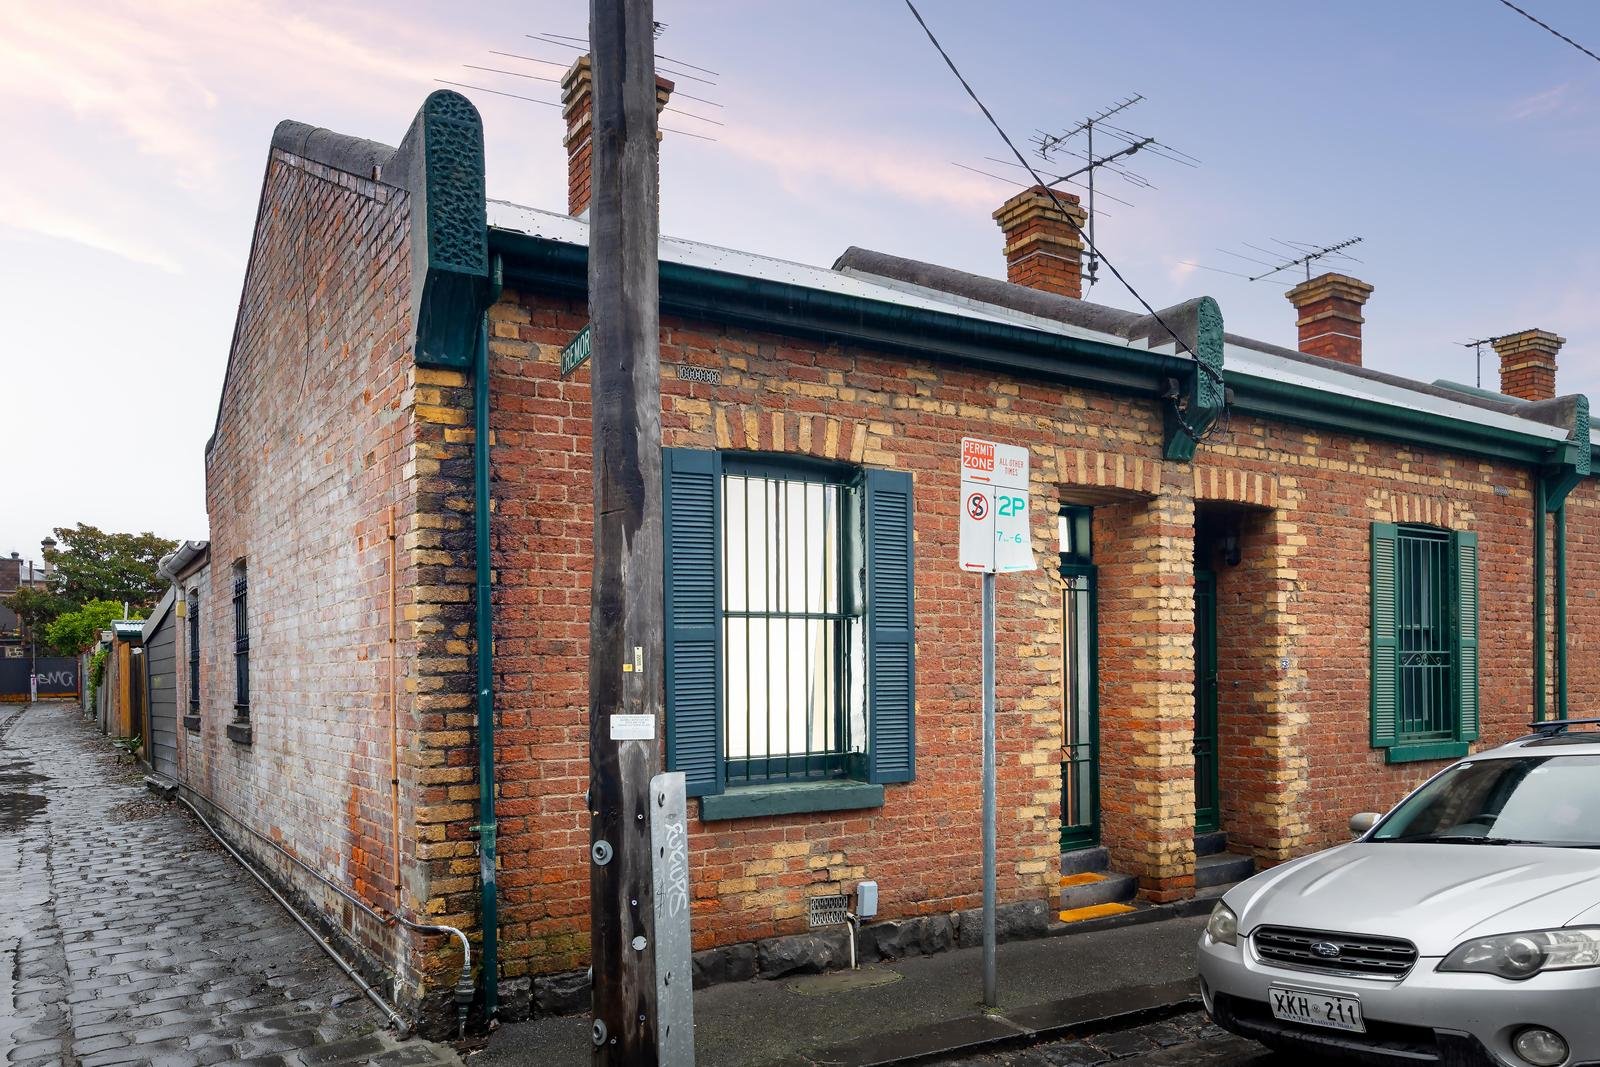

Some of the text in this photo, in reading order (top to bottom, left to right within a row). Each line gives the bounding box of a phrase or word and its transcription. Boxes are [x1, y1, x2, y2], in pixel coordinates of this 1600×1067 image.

[561, 329, 590, 375] CREMOR
[964, 441, 994, 457] PERMIT
[963, 455, 994, 471] ZONE
[998, 495, 1025, 517] 2P
[1274, 993, 1356, 1024] XKH 211
